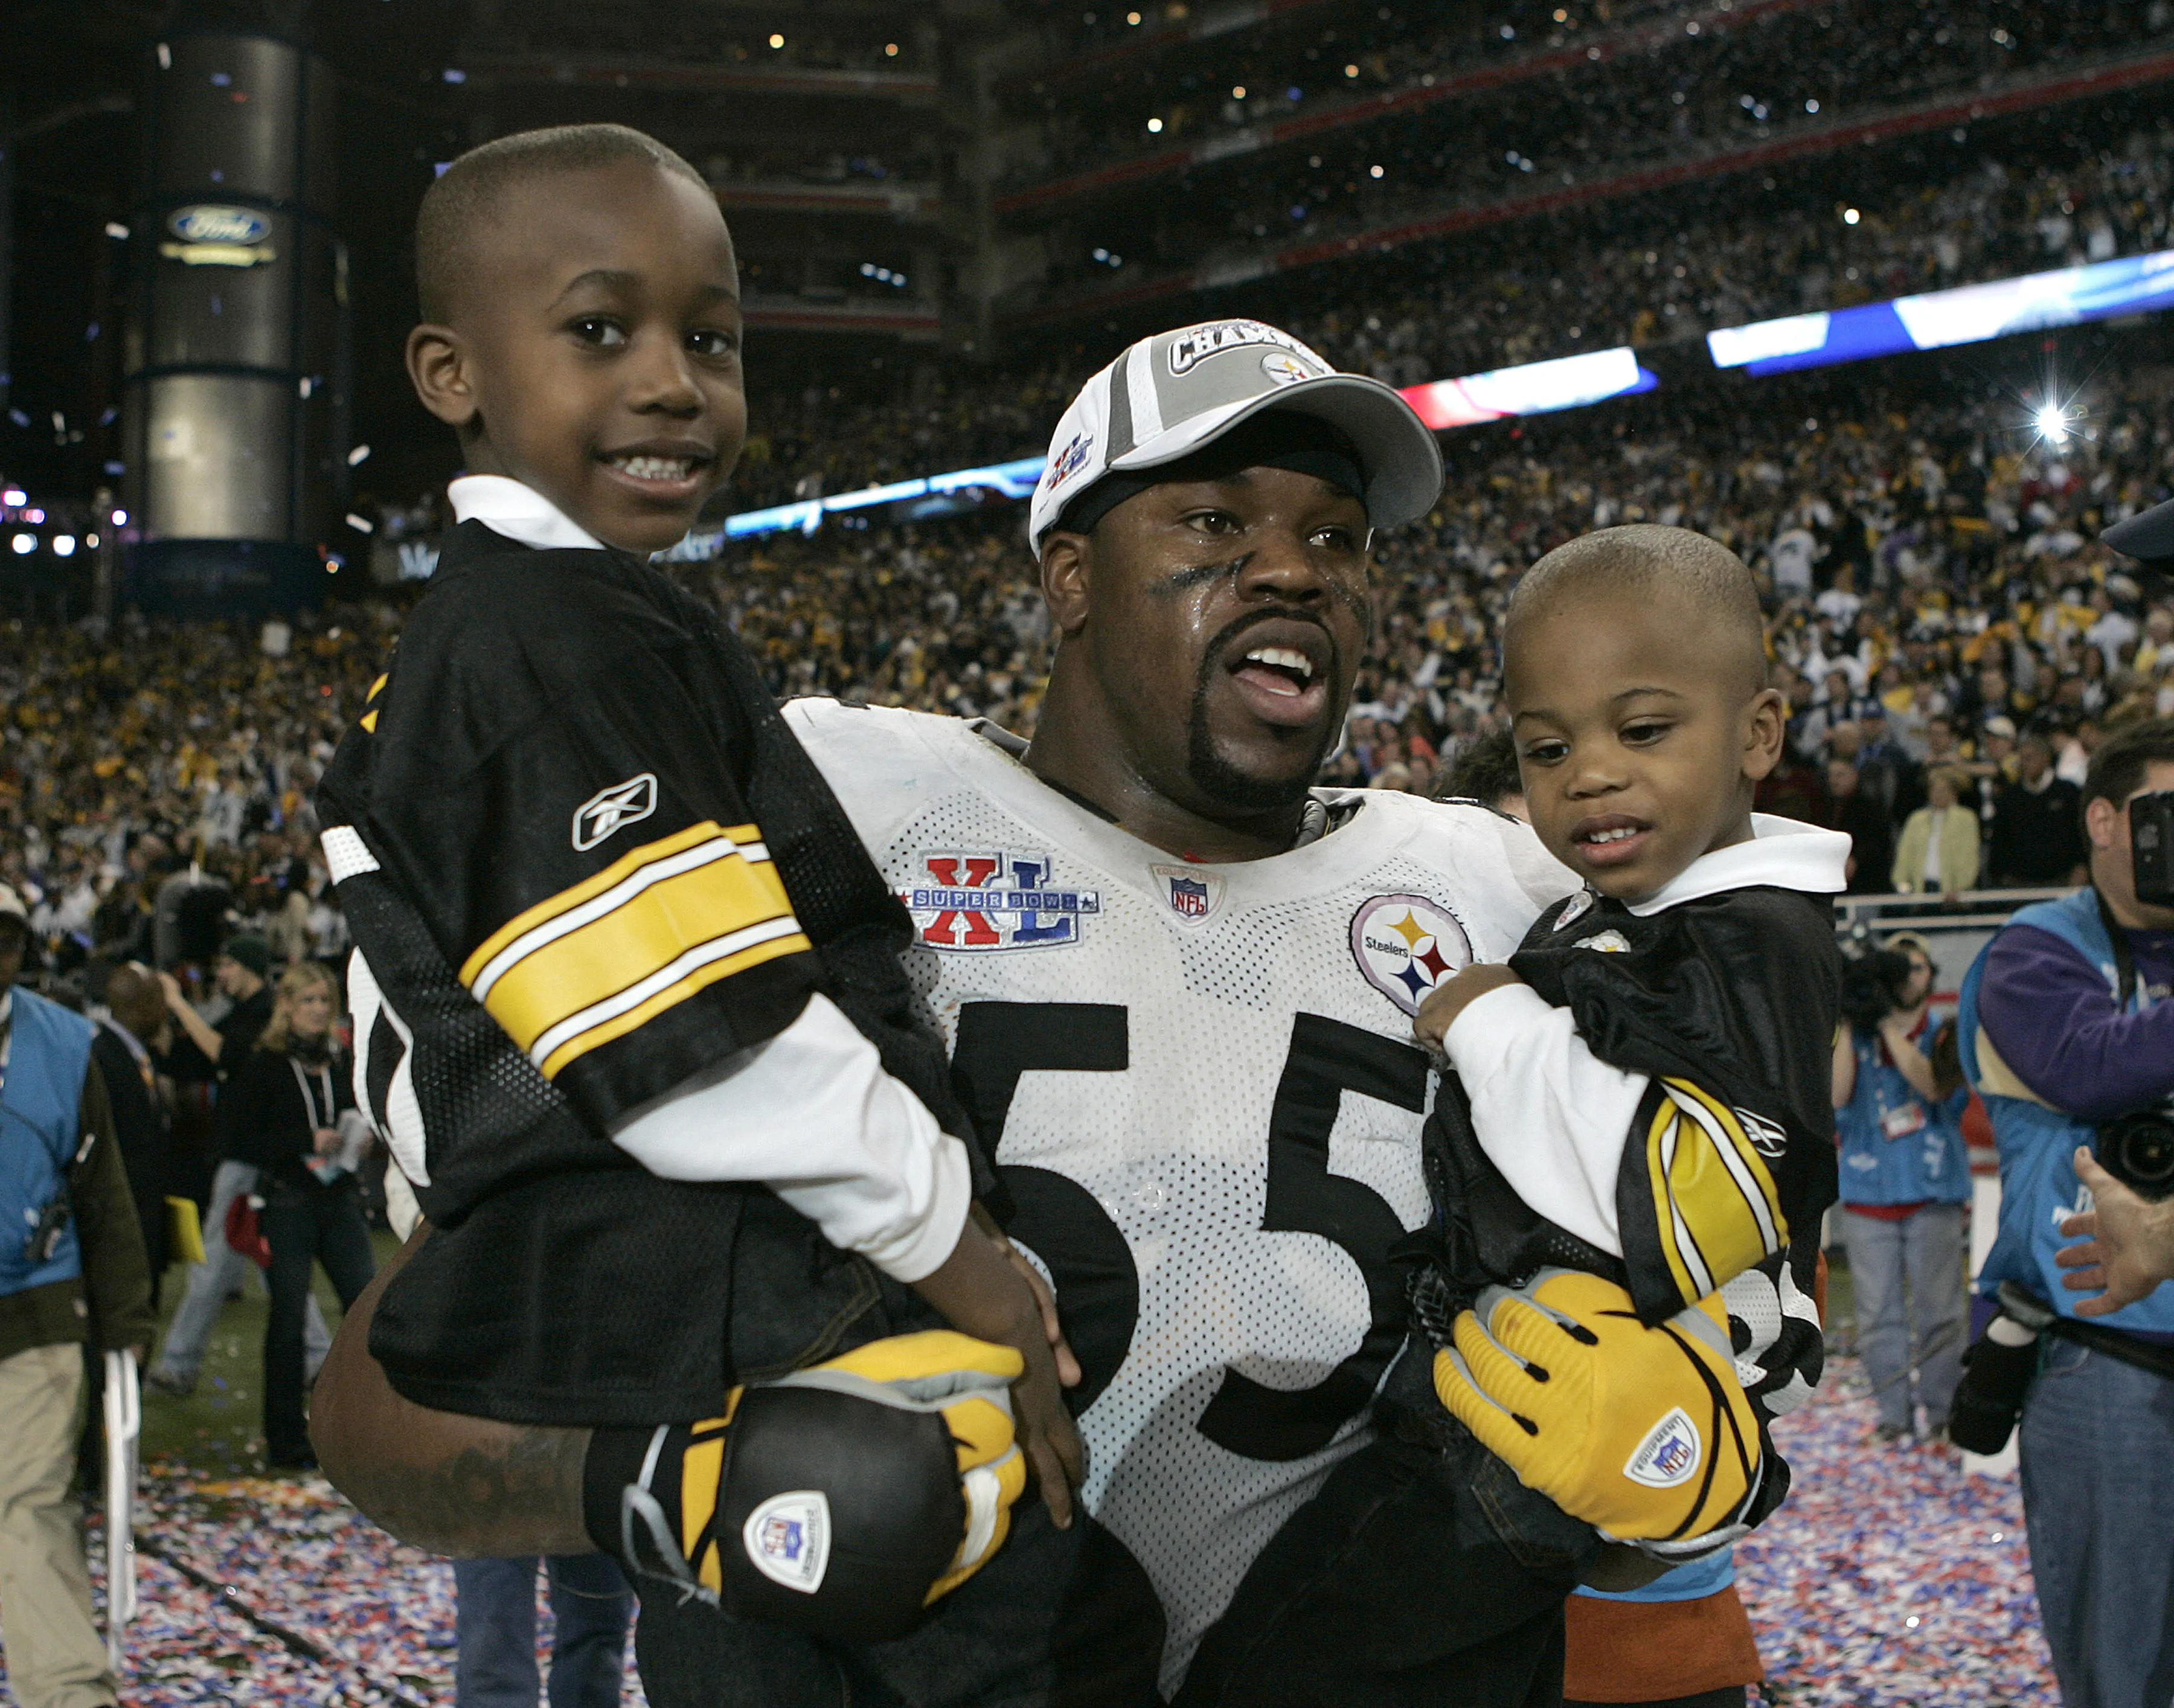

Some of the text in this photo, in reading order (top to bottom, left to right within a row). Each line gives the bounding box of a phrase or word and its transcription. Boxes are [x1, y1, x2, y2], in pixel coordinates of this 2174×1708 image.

[185, 209, 253, 240] Ford
[915, 889, 1077, 908] SUPER BOWL
[924, 858, 1073, 945] XL
[1174, 891, 1205, 914] NFL
[1365, 936, 1408, 958] Steelers
[951, 1000, 1432, 1462] 55
[1661, 1449, 1690, 1475] NFL
